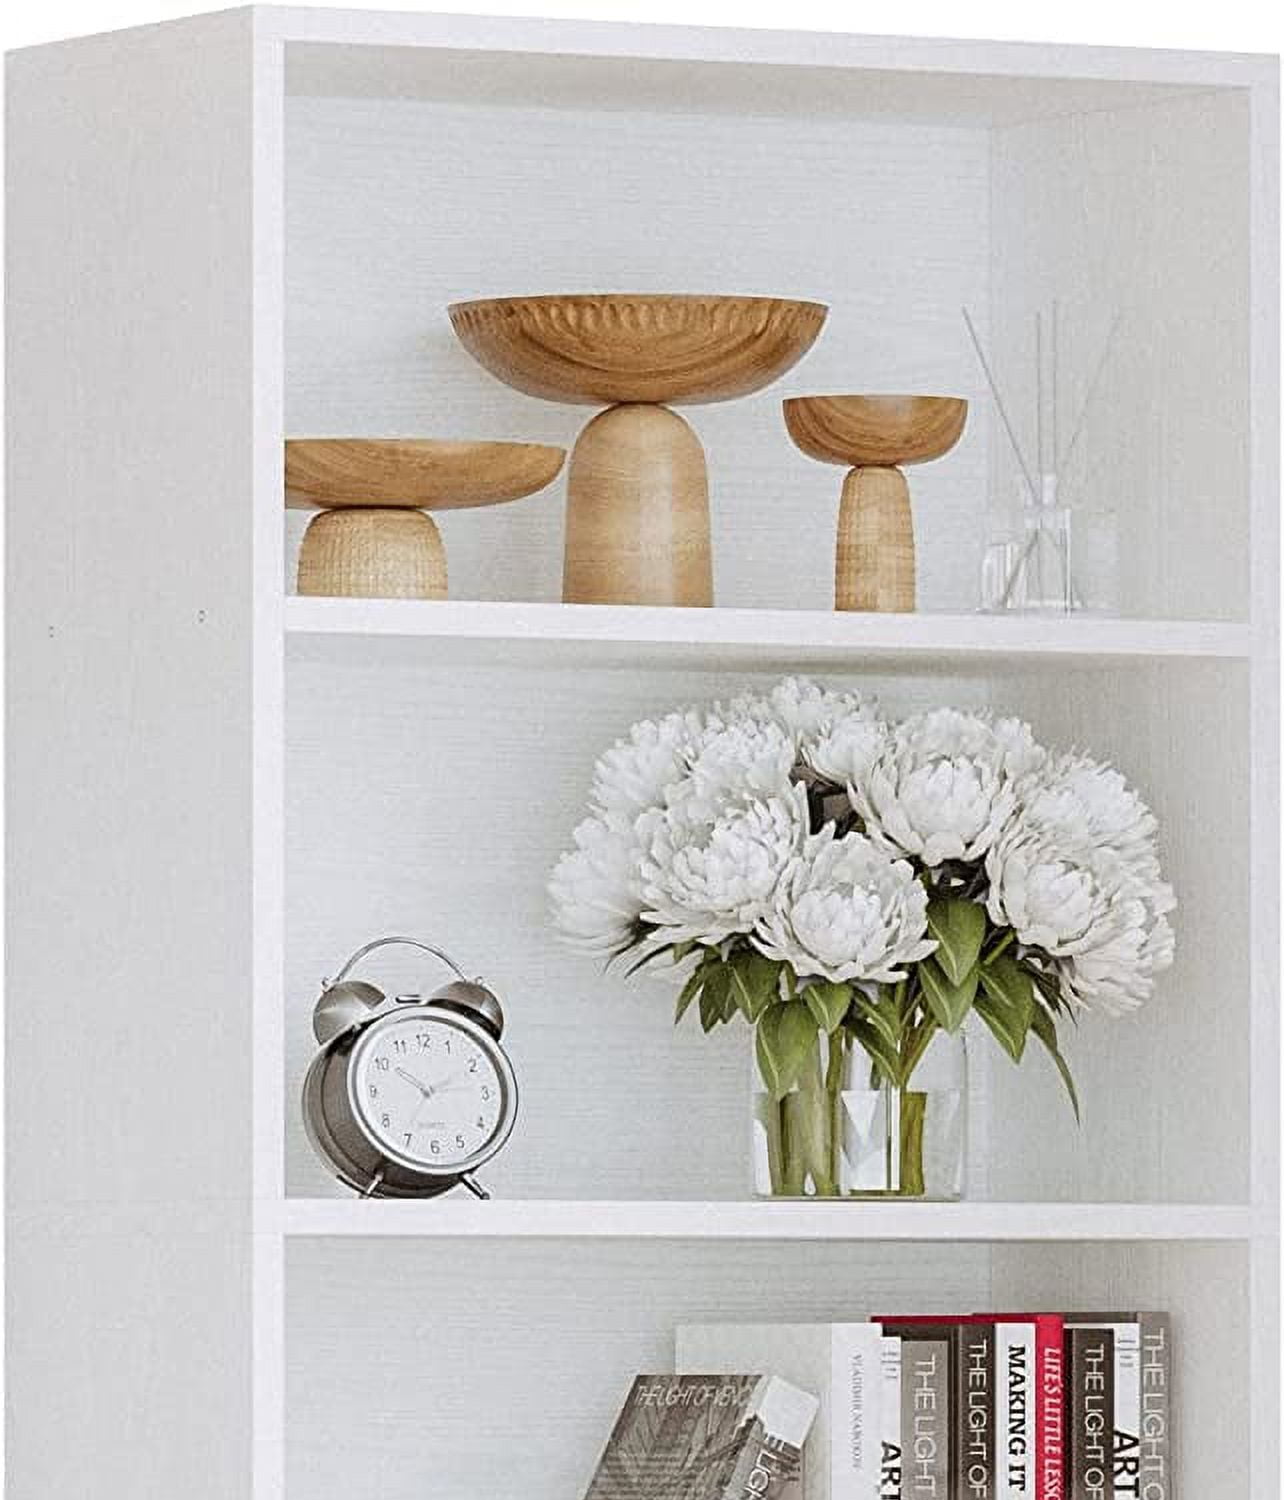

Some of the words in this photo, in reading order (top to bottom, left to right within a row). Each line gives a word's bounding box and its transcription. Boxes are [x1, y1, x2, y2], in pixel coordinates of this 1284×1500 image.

[394, 1040, 407, 1055] 11
[416, 1034, 430, 1049] 12
[444, 1040, 450, 1055] 1
[374, 1057, 389, 1071] 10
[468, 1058, 477, 1073] 2
[482, 1086, 490, 1101] 3
[404, 1133, 412, 1147] 7
[430, 1139, 440, 1154] 6
[456, 1135, 465, 1148] 5
[968, 1341, 987, 1388] THE
[1044, 1347, 1064, 1395] LIFE'S
[1085, 1343, 1104, 1390] THE
[1143, 1327, 1164, 1386] THE
[914, 1354, 936, 1411] THE
[1008, 1344, 1027, 1457] MAKING
[968, 1391, 987, 1461] LIGHT
[1044, 1398, 1063, 1455] LITTLE
[1085, 1395, 1105, 1464] LIGHT
[1143, 1393, 1165, 1478] LIGHT
[914, 1416, 937, 1498] LIGHT
[1008, 1464, 1026, 1491] IT
[1113, 1430, 1140, 1499] ART
[968, 1464, 987, 1499] OF
[1085, 1467, 1105, 1500] OF
